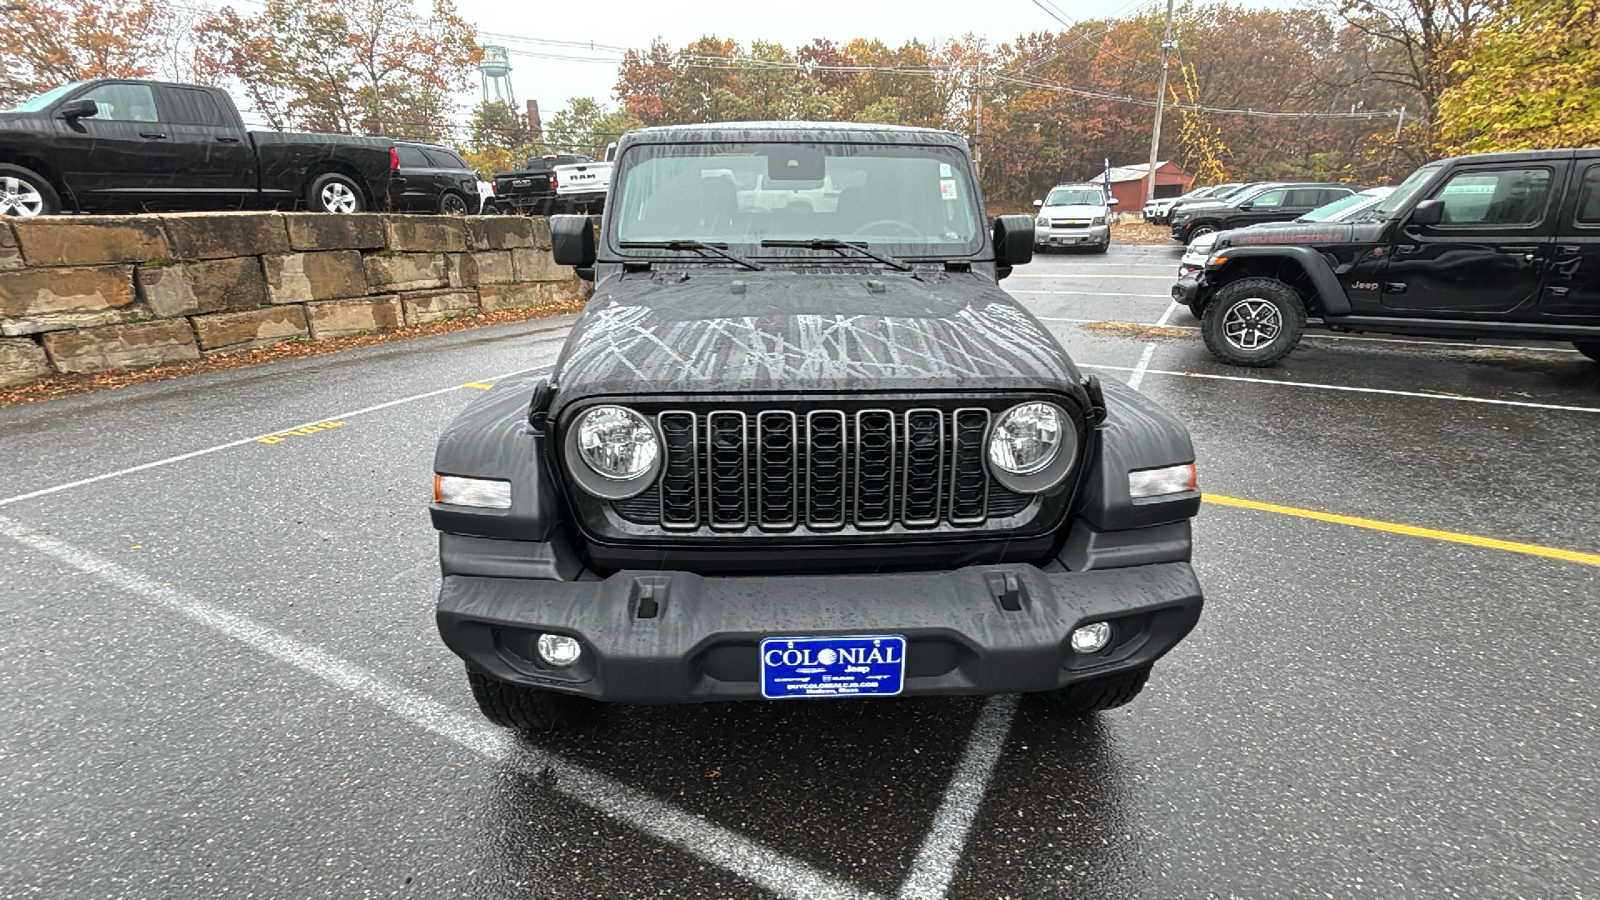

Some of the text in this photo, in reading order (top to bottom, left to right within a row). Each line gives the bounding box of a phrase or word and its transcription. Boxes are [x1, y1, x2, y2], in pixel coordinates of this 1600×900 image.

[569, 173, 596, 181] RAM
[1351, 281, 1379, 291] Jeep
[764, 647, 901, 667] COLONIAL
[844, 664, 870, 674] Jeep
